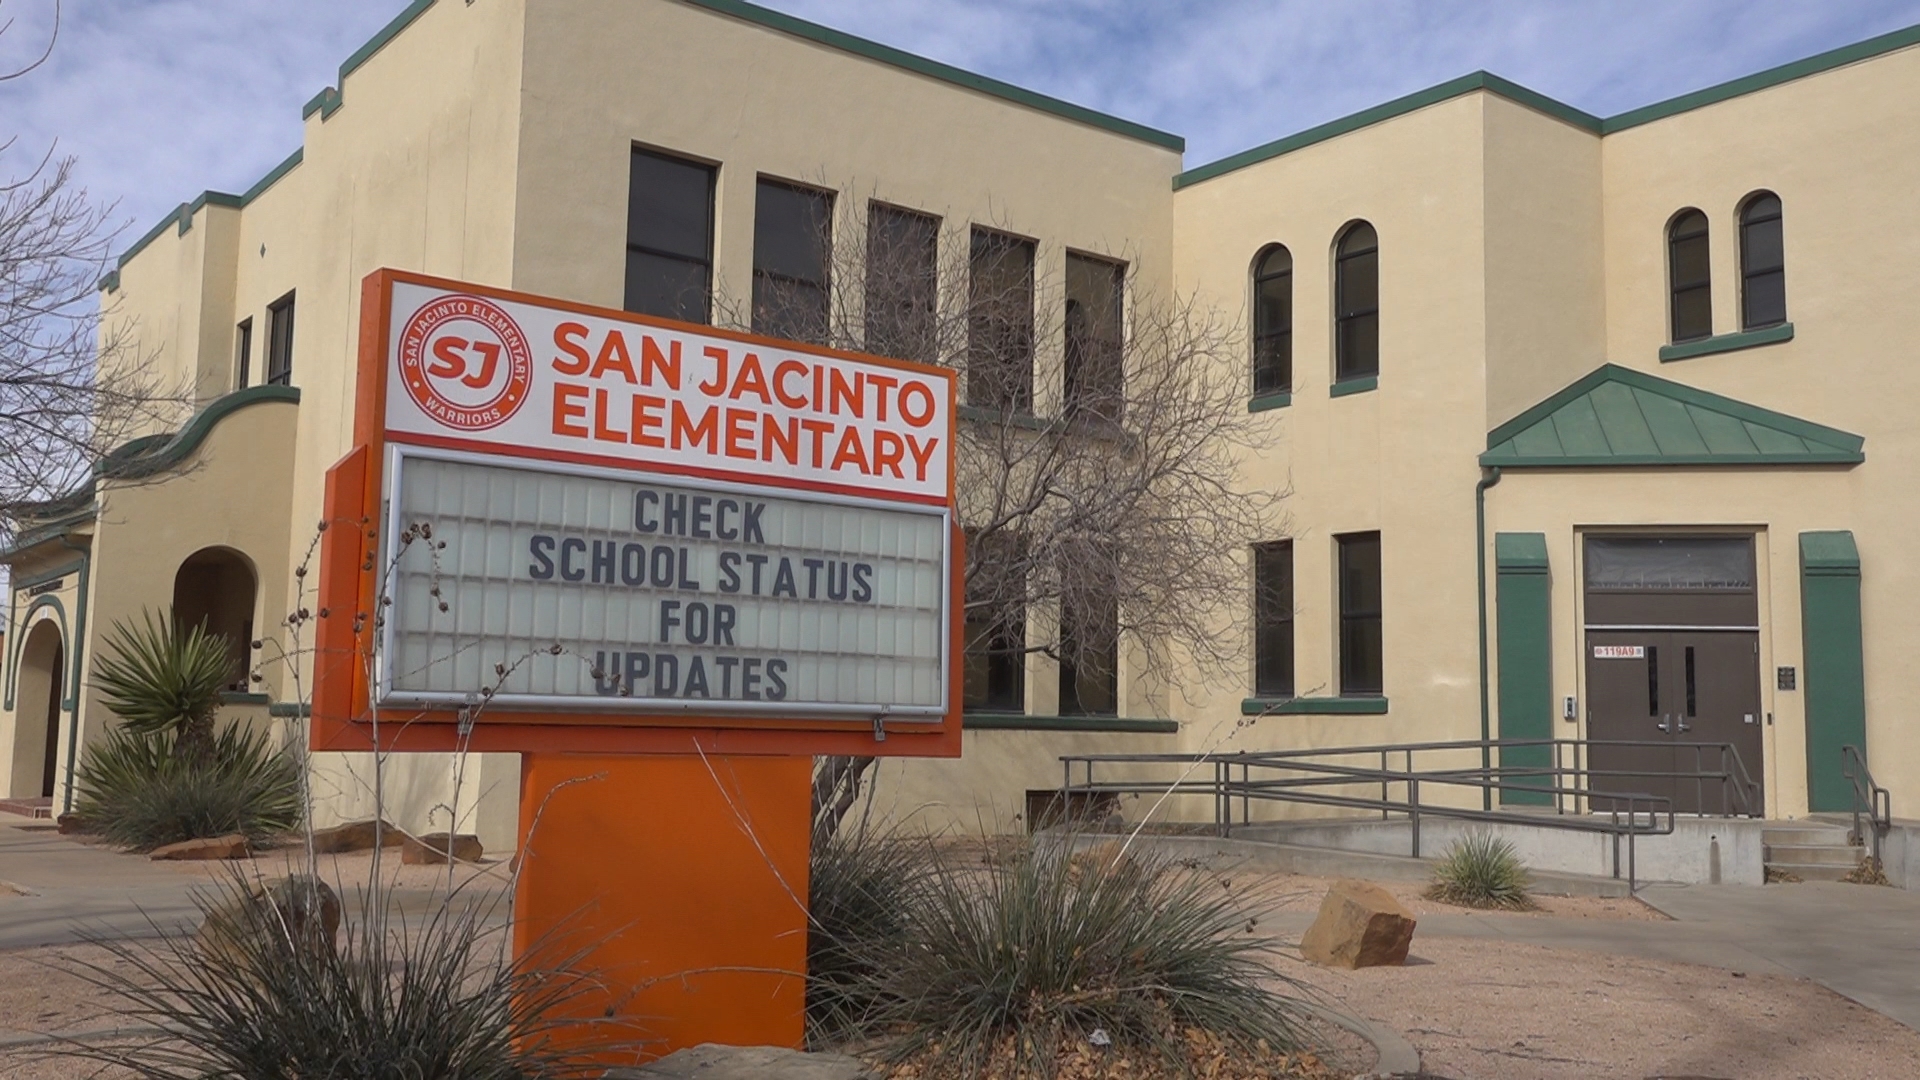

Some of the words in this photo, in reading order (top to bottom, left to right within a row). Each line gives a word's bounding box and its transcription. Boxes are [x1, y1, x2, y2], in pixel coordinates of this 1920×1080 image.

[406, 336, 420, 367] SAN
[414, 302, 467, 335] JACINTO
[472, 304, 525, 384] ELEMENTARY
[427, 335, 501, 389] SJ
[551, 322, 682, 391] SAN
[698, 345, 936, 428] JACINTO
[425, 396, 500, 425] WARRIORS
[552, 382, 939, 482] ELEMENTARY
[635, 490, 766, 544] CHECK
[529, 535, 699, 590] SCHOOL
[719, 552, 872, 602] STATUS
[660, 600, 736, 646] FOR
[595, 651, 787, 700] UPDATES
